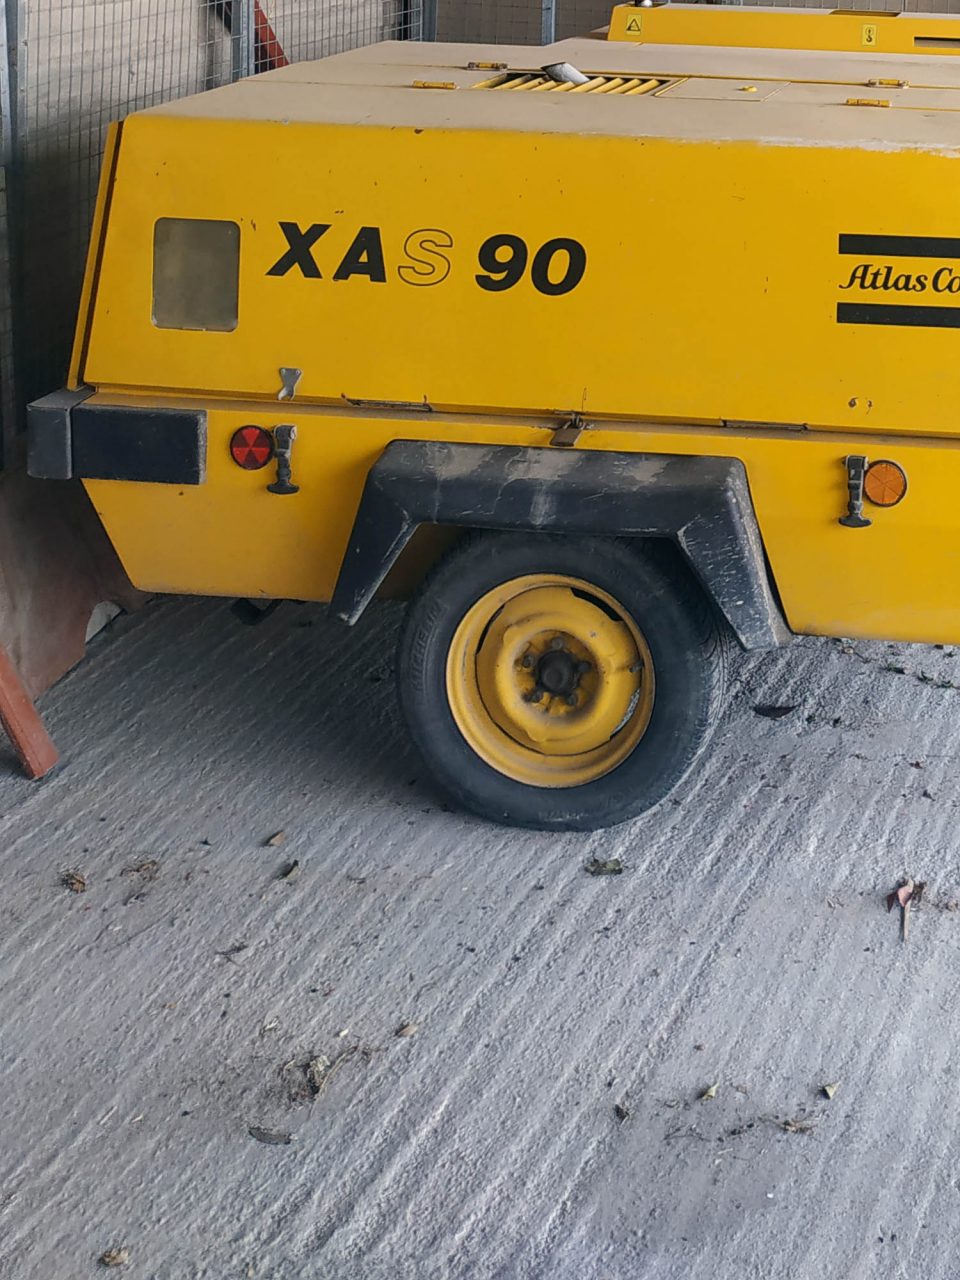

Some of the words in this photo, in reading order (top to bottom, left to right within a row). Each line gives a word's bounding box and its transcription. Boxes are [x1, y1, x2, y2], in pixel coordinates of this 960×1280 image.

[265, 221, 453, 286] XAS
[475, 234, 587, 296] 90
[838, 264, 928, 292] Atlas
